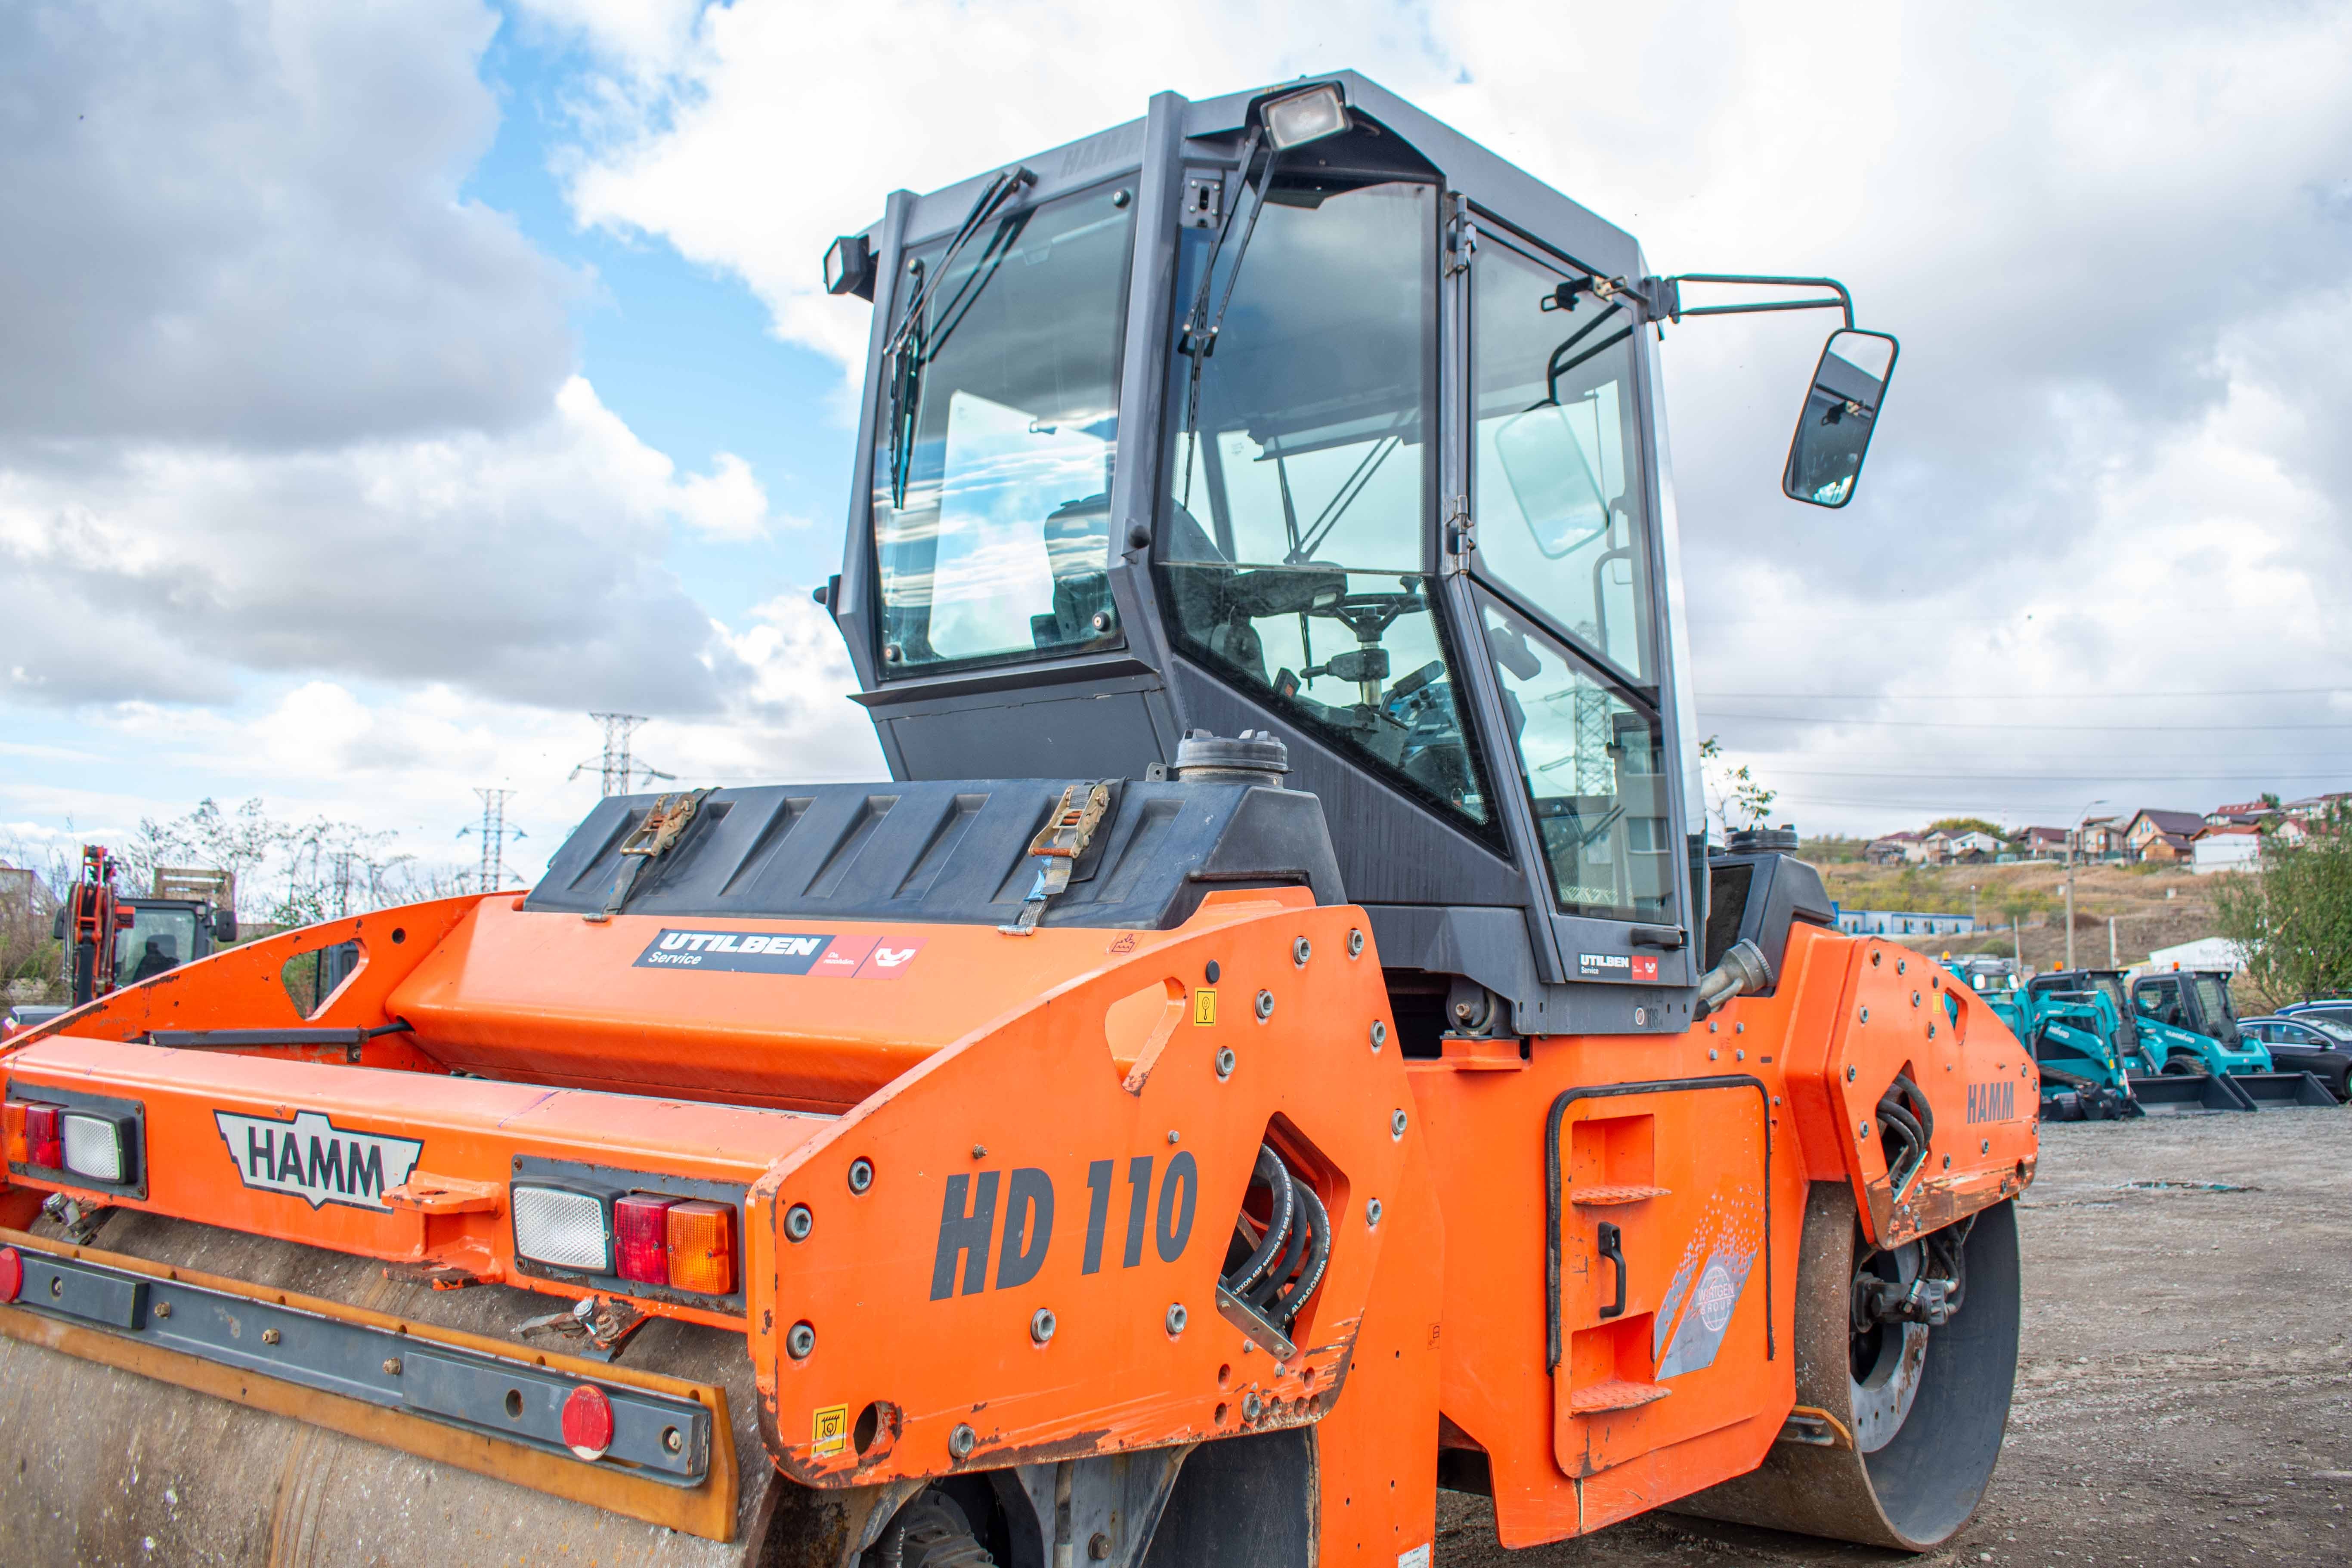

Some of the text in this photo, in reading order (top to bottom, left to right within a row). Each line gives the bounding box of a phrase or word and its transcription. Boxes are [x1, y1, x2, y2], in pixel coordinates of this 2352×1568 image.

[648, 951, 702, 965] Service
[659, 932, 822, 956] UTILBEN
[1580, 953, 1629, 968] UTILBEN
[1581, 966, 1599, 974] Service
[1967, 1081, 2014, 1124] HAMM
[248, 1126, 386, 1200] HAMM
[929, 1150, 1198, 1301] HD 110
[1232, 1277, 1253, 1295] LEXOR
[1263, 1240, 1281, 1267] exceeds
[1278, 1229, 1286, 1241] EN
[1292, 1259, 1327, 1314] ALFAGOMMA
[1701, 1298, 1732, 1315] GROUP
